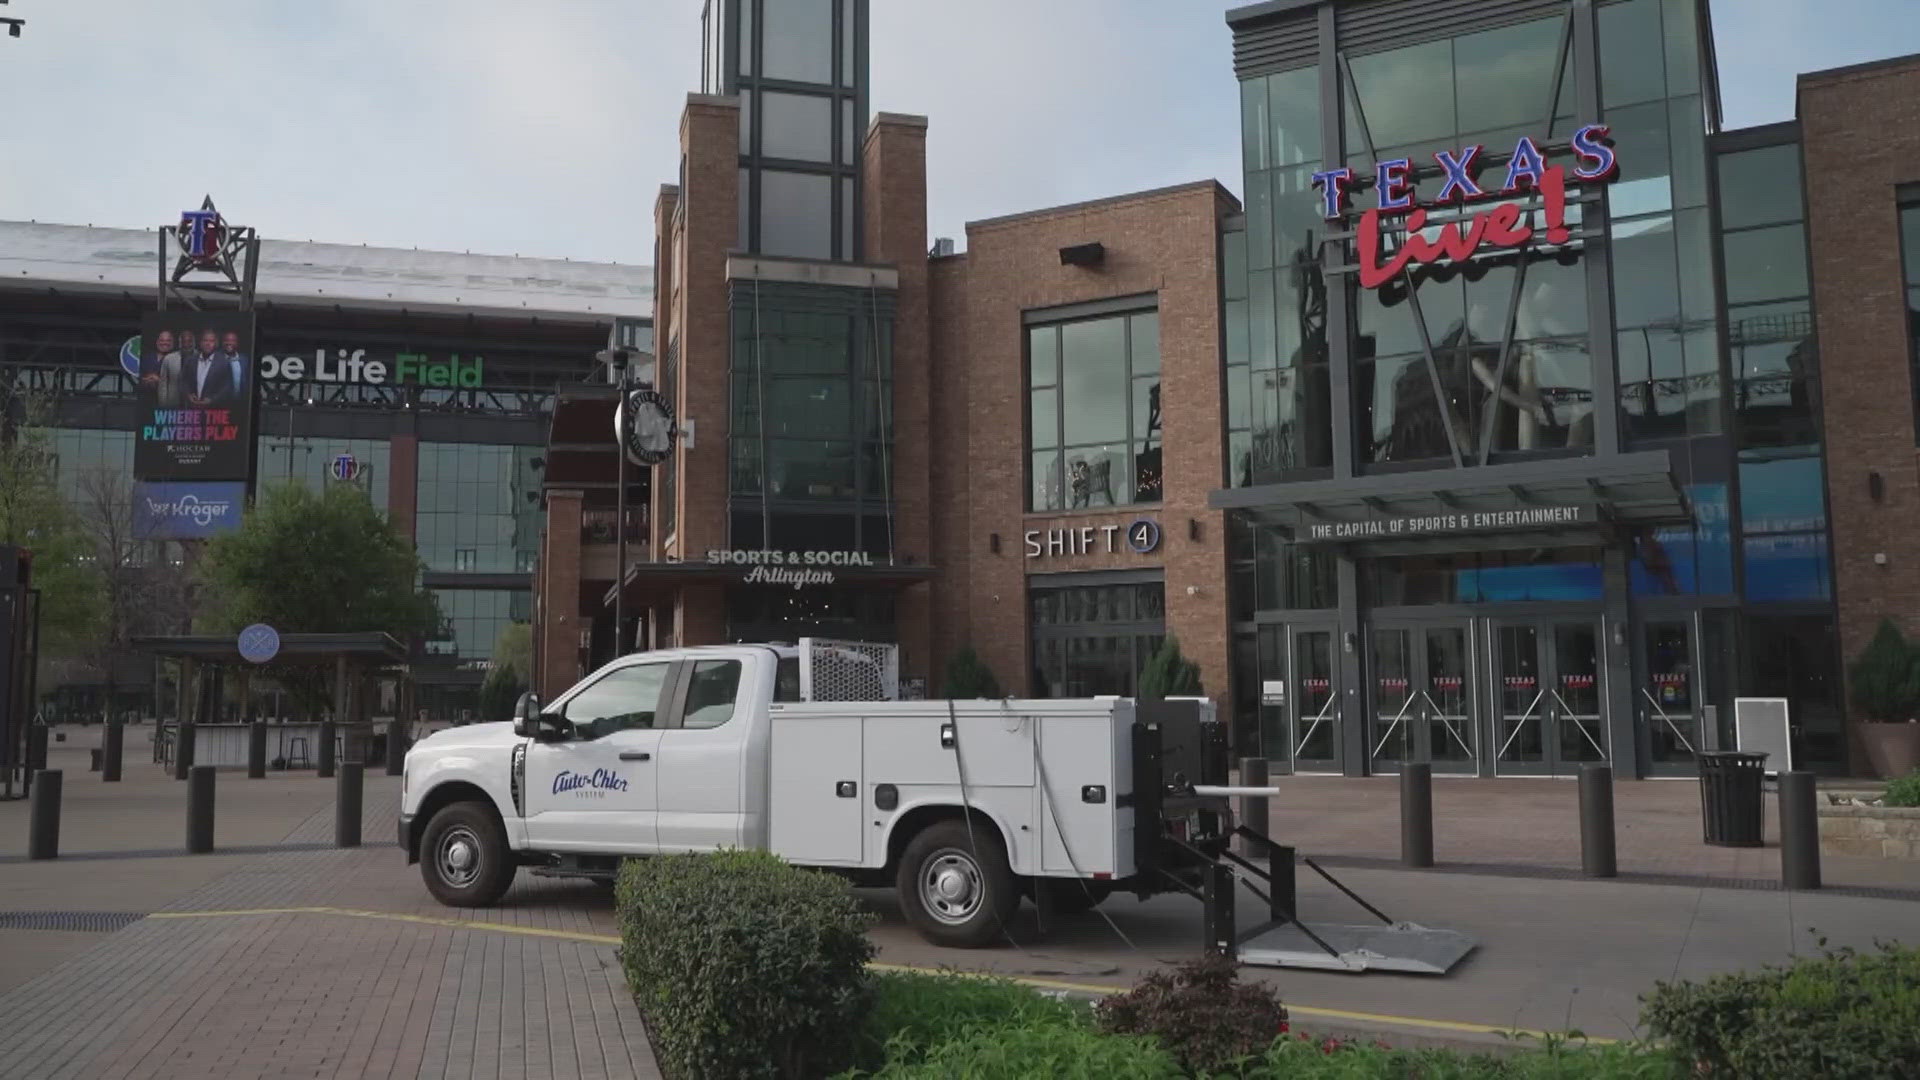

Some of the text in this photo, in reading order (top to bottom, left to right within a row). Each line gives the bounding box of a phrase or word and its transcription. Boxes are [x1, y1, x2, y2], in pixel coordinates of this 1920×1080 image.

[1311, 125, 1618, 219] TEXAS
[1357, 164, 1569, 289] Live!
[315, 349, 387, 384] Life
[395, 352, 484, 388] Field
[154, 409, 230, 424] WHERE THE
[143, 425, 238, 441] PLAYERS PLAY
[172, 494, 230, 526] Kroger
[1312, 506, 1579, 538] THE CAPITAL OF SPORTS & ENTERTAINMENT
[1025, 525, 1118, 557] SHIFT
[707, 549, 873, 566] SPORTS & SOCIAL
[743, 564, 835, 590] Arlington
[1504, 676, 1536, 684] TEXAS
[575, 791, 605, 799] SYSTEM
